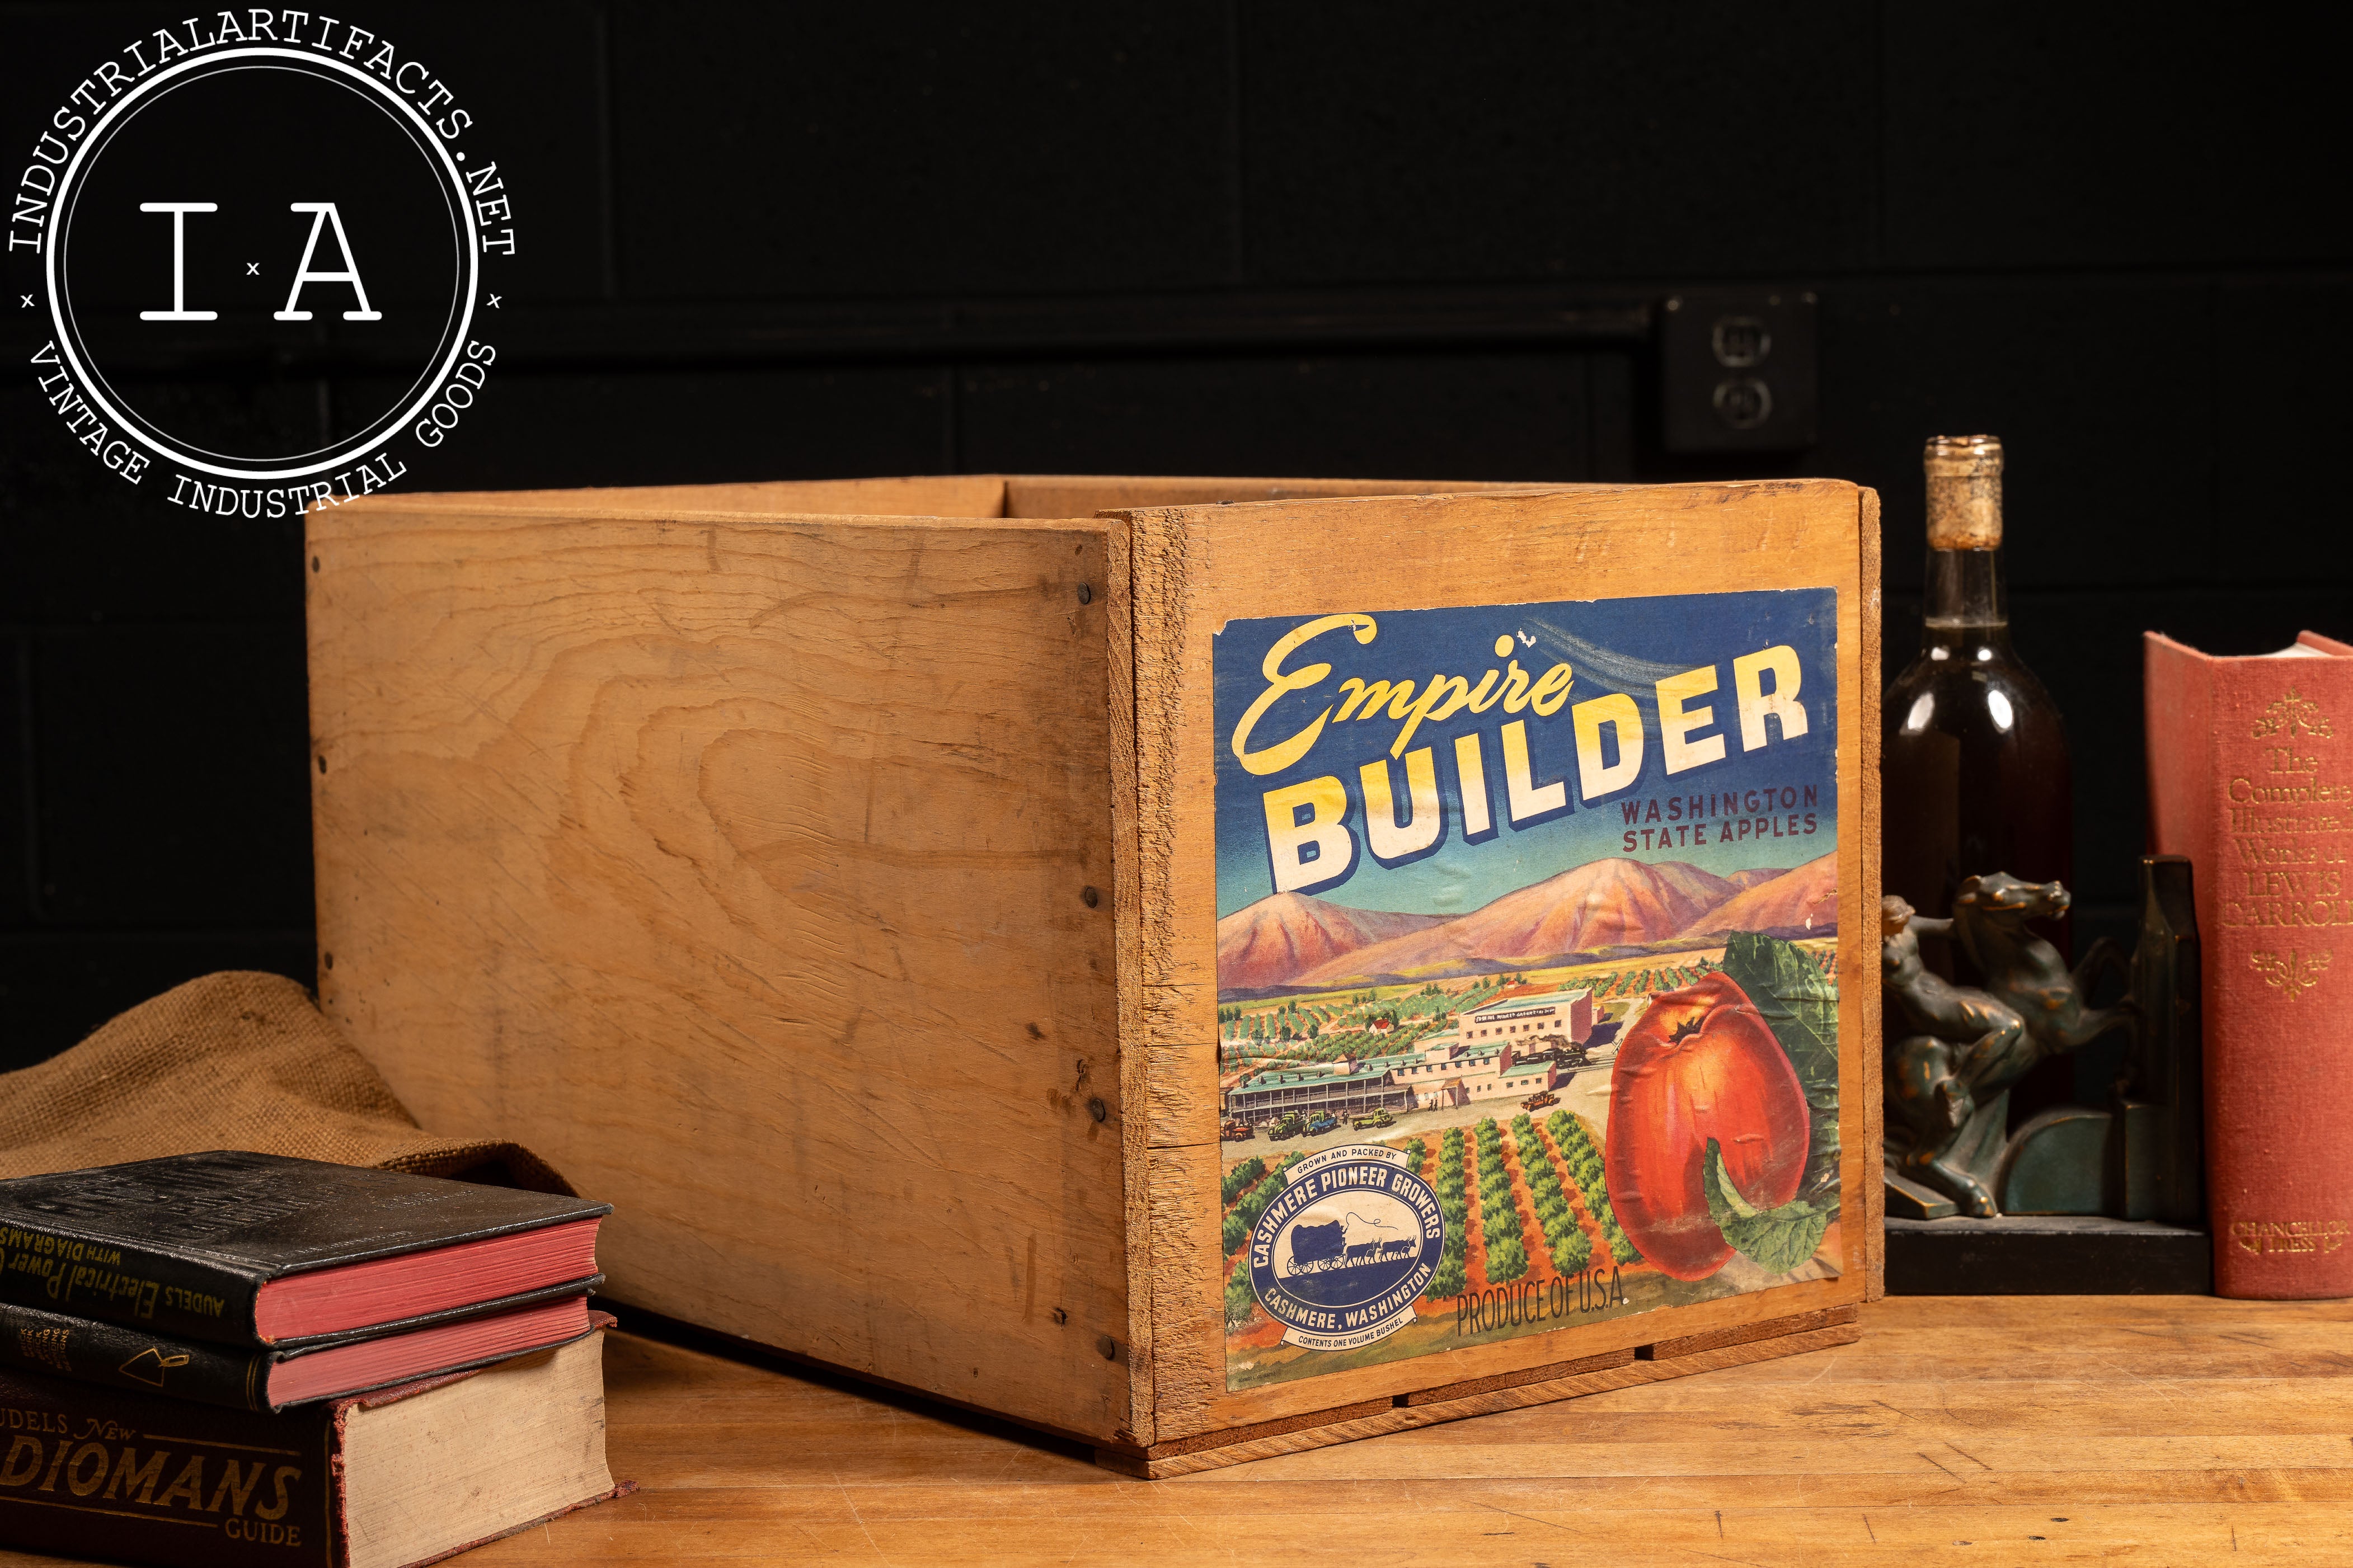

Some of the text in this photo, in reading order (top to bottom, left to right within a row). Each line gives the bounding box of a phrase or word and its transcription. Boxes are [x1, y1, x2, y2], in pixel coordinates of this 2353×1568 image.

[1232, 613, 1574, 776] Empire
[1263, 645, 1809, 894] BUILDER
[2263, 747, 2318, 774] The
[1621, 784, 1817, 825] WASHINGTON
[2229, 776, 2353, 810] Complete
[1623, 813, 1817, 853] STATE APPLES
[2233, 837, 2318, 864] Works
[2243, 871, 2341, 897] LEWIS
[1297, 1148, 1397, 1174] GROWN AND PACKED BY
[1253, 1166, 1440, 1268] CASHMERE PIONEER GROWERS
[2230, 1220, 2350, 1237] CHANCELLOR
[0, 1227, 85, 1263] DIAGRAMS
[86, 1245, 121, 1266] WITH
[7, 1252, 67, 1299] Power
[65, 1264, 160, 1320] Electrical
[165, 1286, 224, 1317] AUDELS
[1264, 1263, 1431, 1330] CASHMERE, WASHINGTON
[1457, 1279, 1547, 1336] PRODUCE
[1550, 1274, 1574, 1319] OF
[1298, 1335, 1332, 1347] CONTENTS
[1348, 1331, 1375, 1345] VOLUME
[1376, 1317, 1403, 1336] BUSHEL
[225, 1518, 302, 1548] GUIDE
